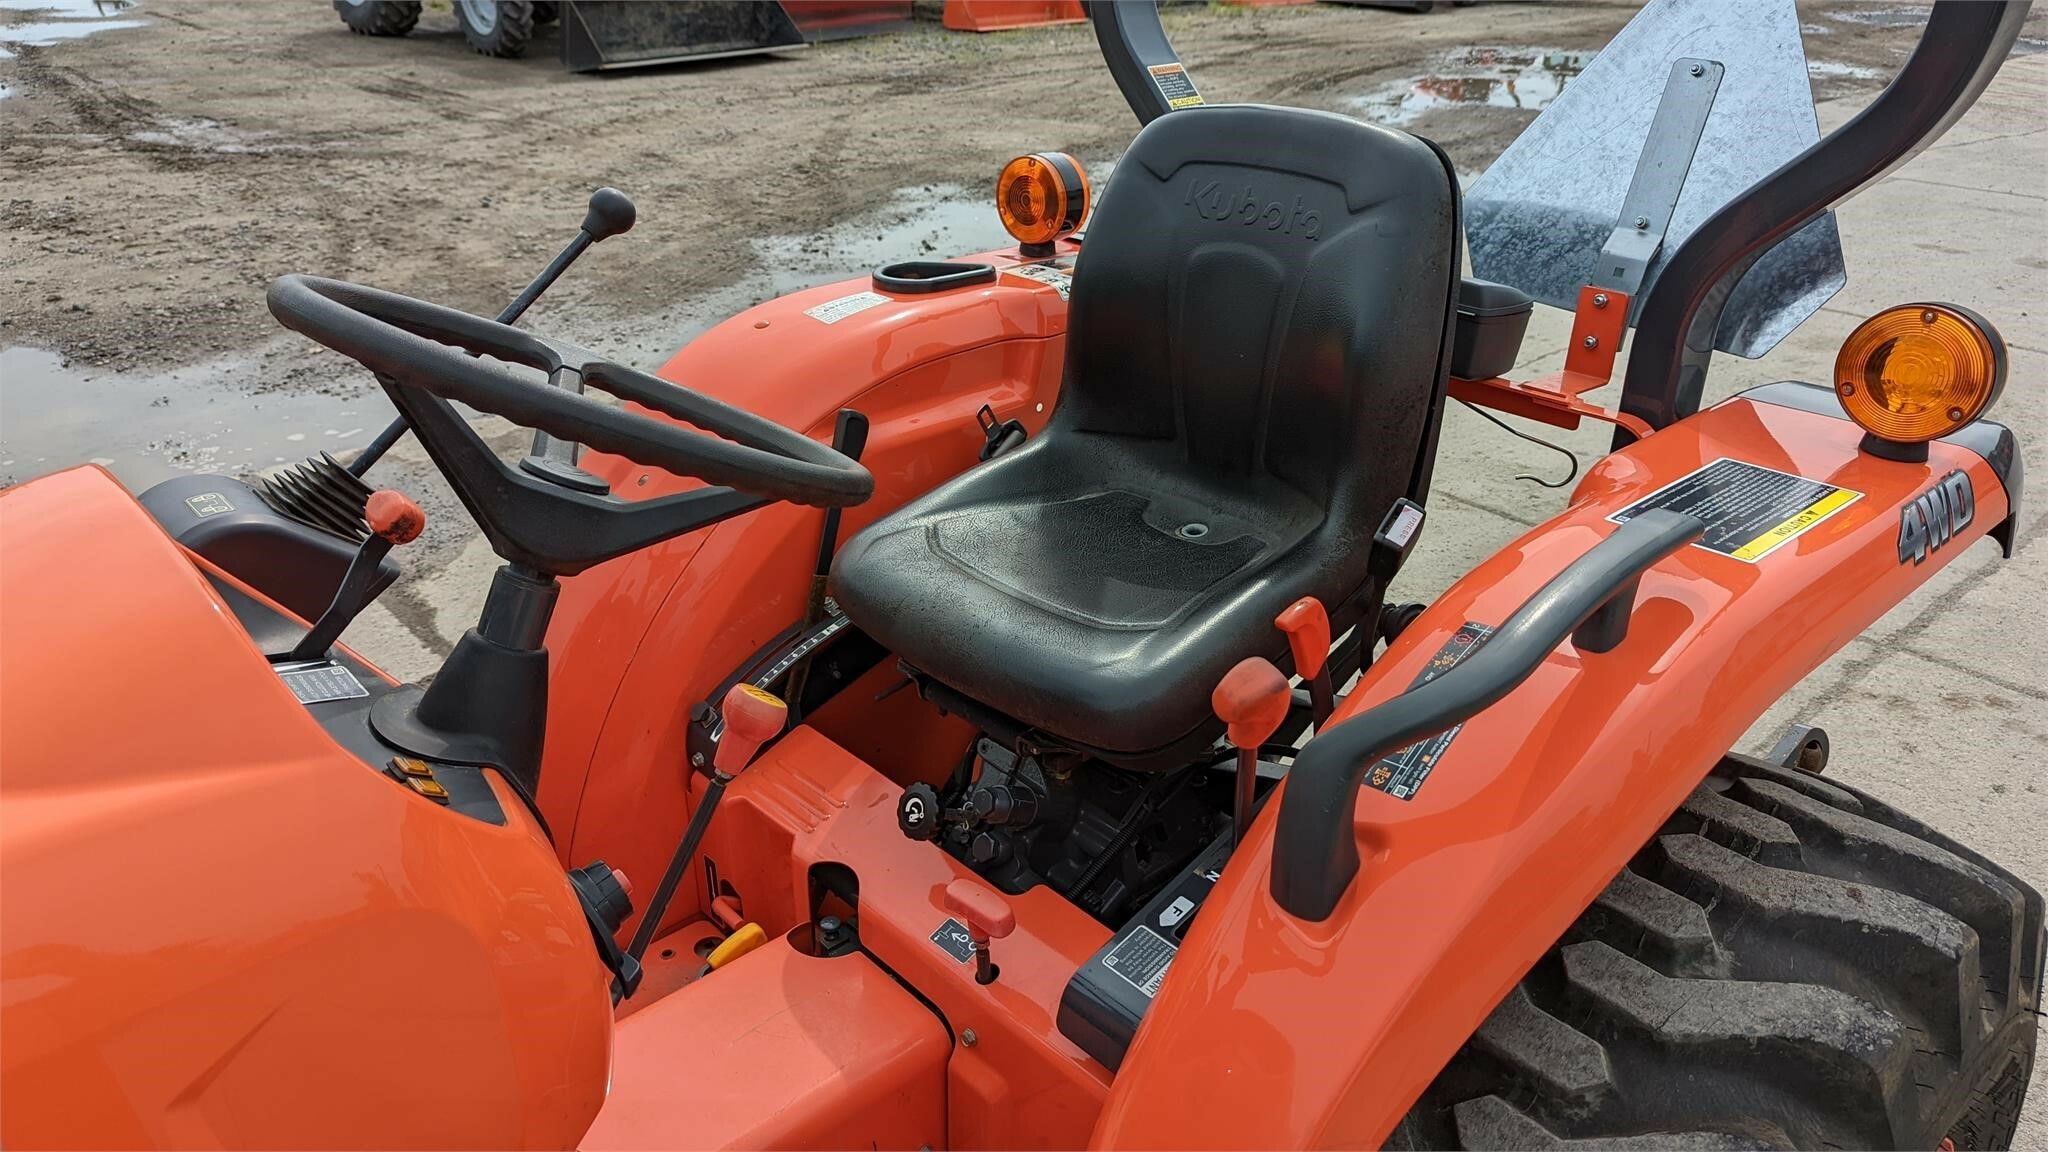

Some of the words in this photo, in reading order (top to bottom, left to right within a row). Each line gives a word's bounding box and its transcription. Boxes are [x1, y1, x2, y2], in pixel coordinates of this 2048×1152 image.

[1184, 178, 1322, 241] Kubota
[1771, 514, 1814, 537] CAUTION
[1896, 467, 1975, 568] 4WD
[1428, 741, 1449, 767] Particulate
[1418, 767, 1430, 780] Filter
[1173, 905, 1184, 917] F
